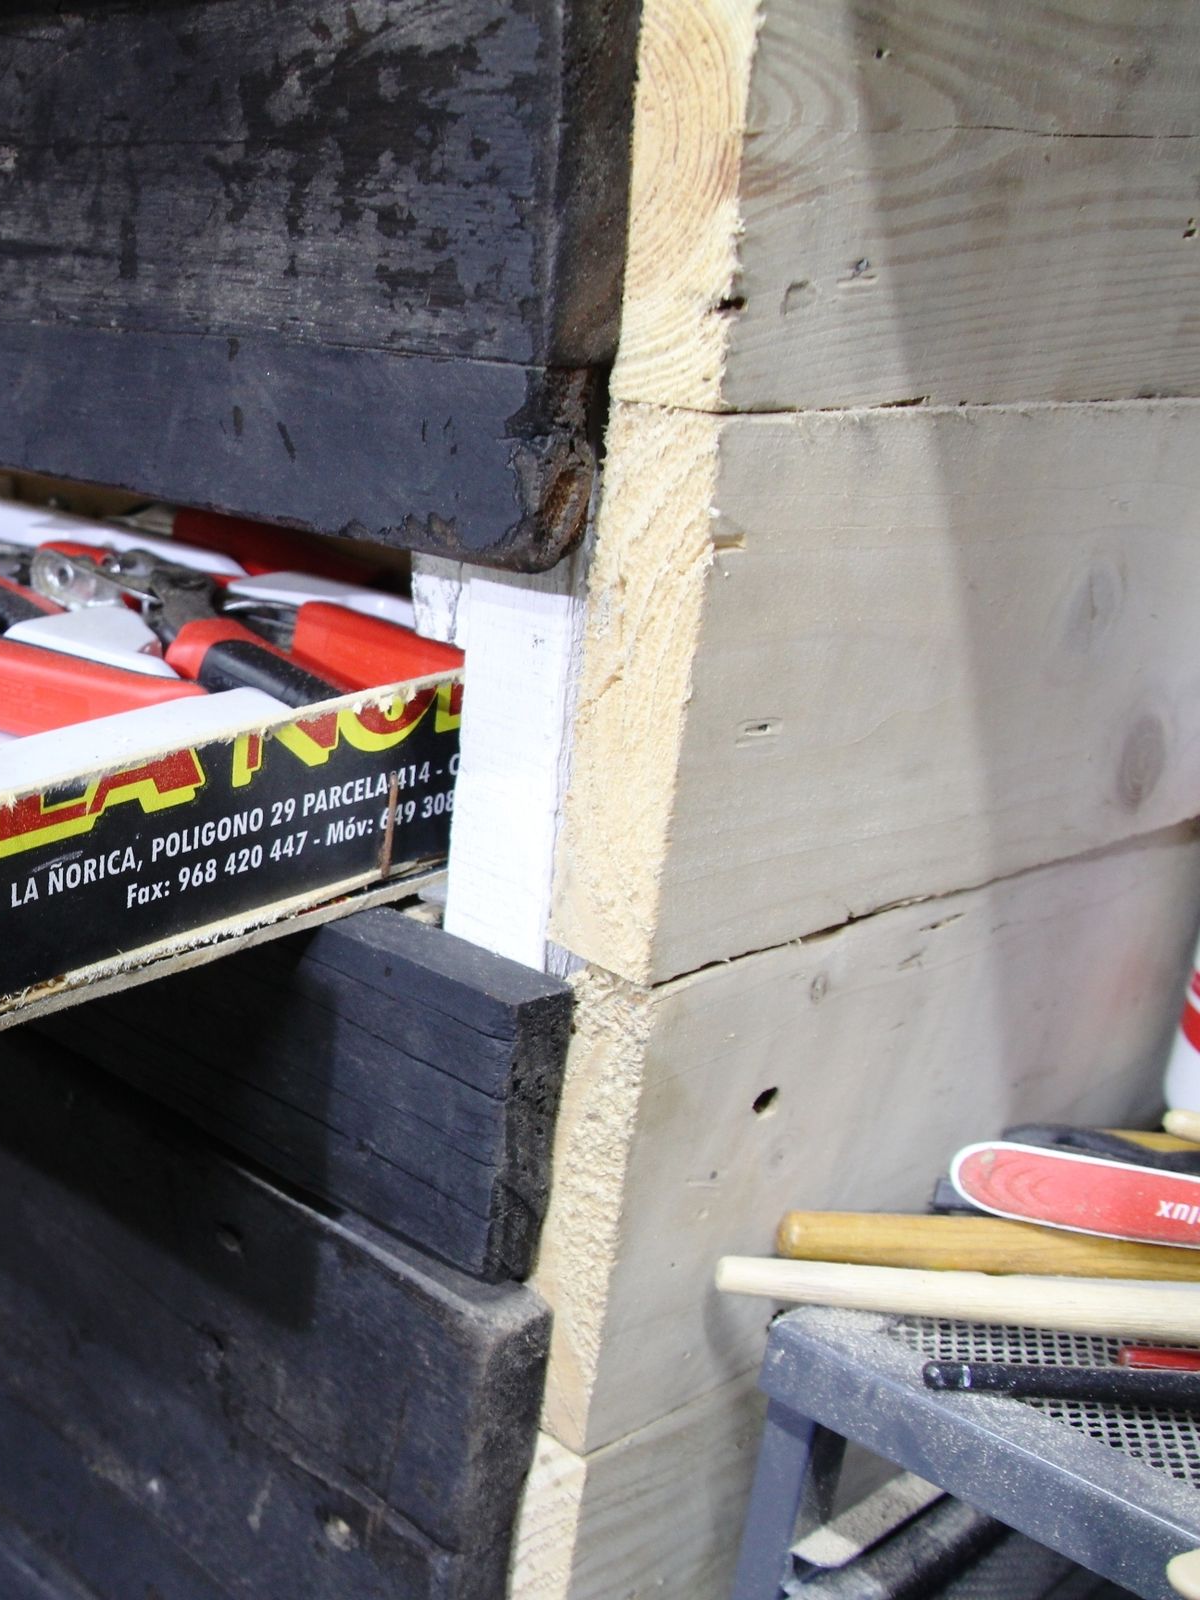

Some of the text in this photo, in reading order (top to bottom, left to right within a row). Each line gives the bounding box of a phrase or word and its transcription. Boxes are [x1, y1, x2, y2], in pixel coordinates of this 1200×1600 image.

[10, 876, 40, 908] LA
[48, 846, 144, 896] ÑORICA,
[151, 808, 264, 863] POLIGONO
[270, 798, 296, 827] 29
[303, 772, 388, 817] PARCELA
[126, 880, 170, 909] Fax:
[178, 858, 218, 892] 968
[224, 845, 263, 875] 420
[269, 831, 309, 862] 447
[325, 815, 373, 847] Móv:
[1154, 1199, 1200, 1225] lux
